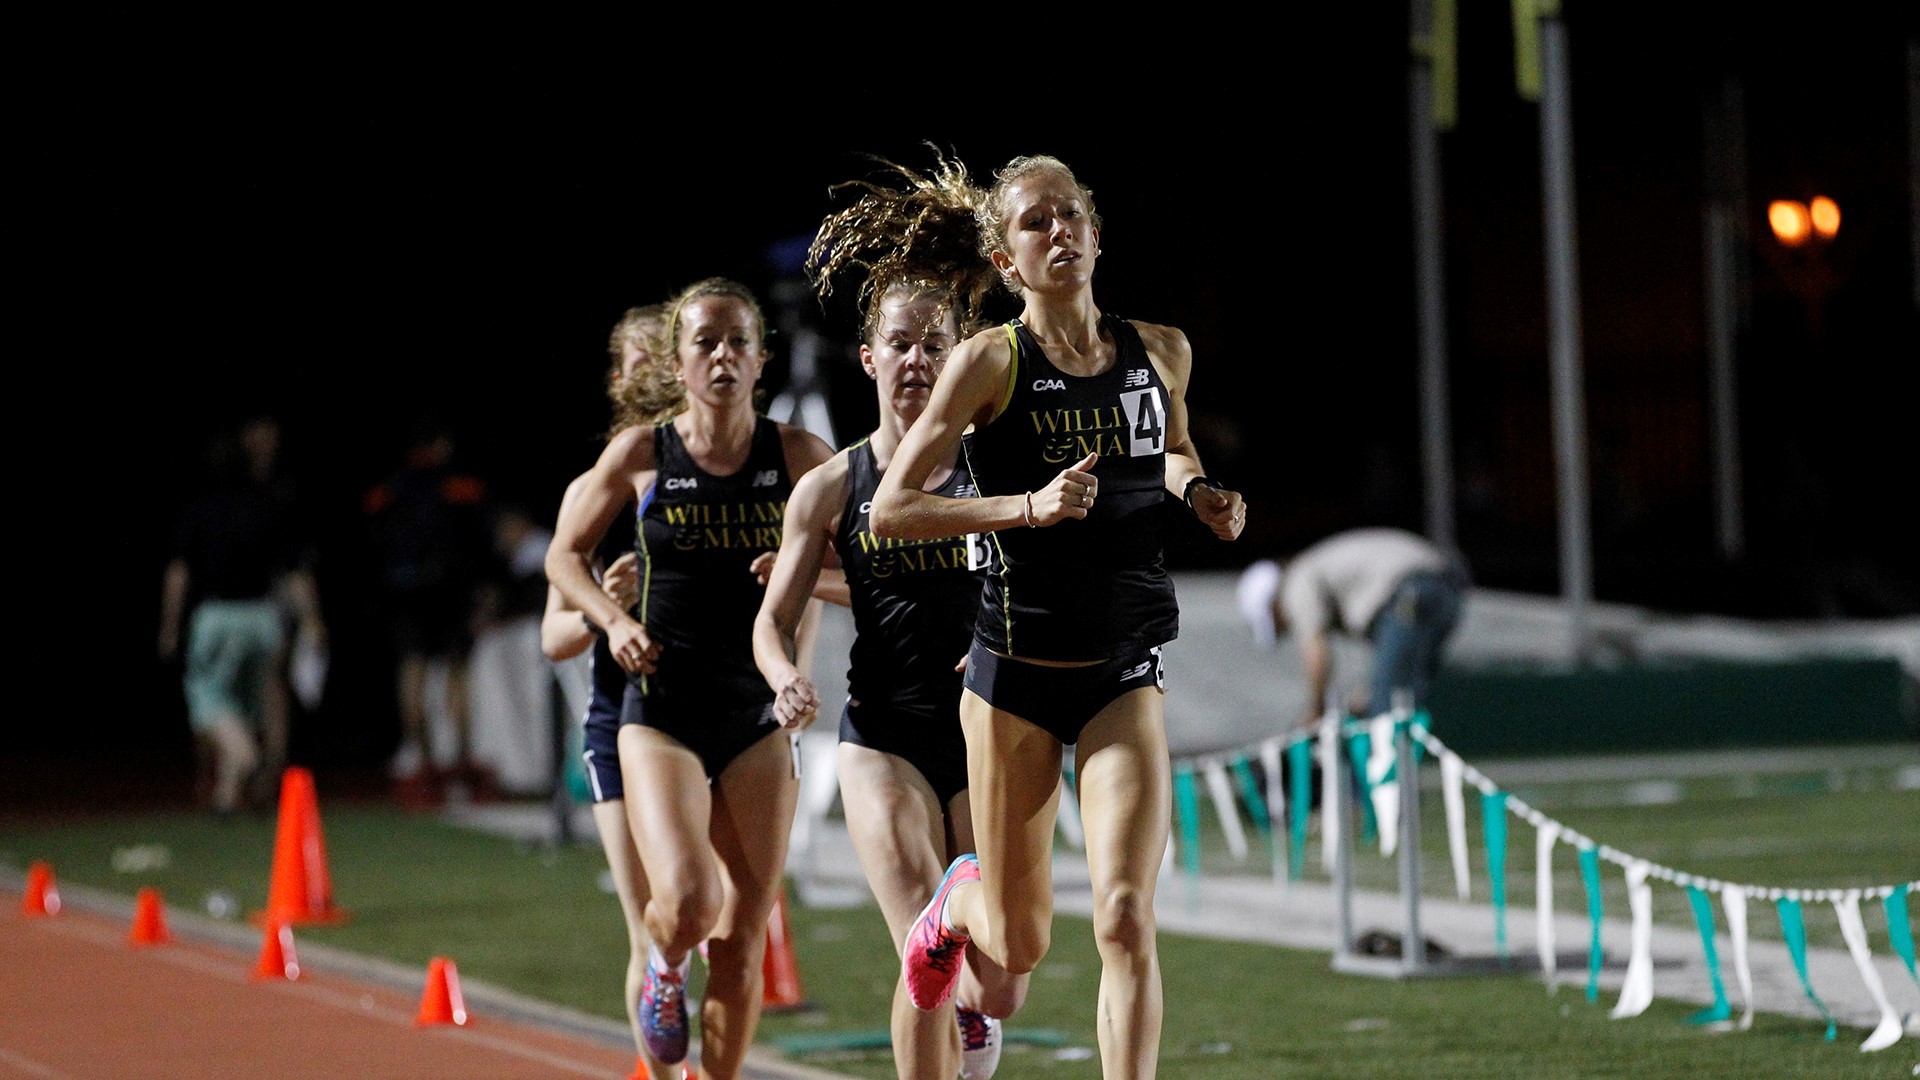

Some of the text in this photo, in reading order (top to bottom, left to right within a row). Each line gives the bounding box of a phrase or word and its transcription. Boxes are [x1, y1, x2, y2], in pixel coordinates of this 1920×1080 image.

[1032, 379, 1066, 391] CAA
[1029, 406, 1128, 435] WILLI
[1134, 392, 1162, 449] 4
[665, 477, 698, 490] CAA
